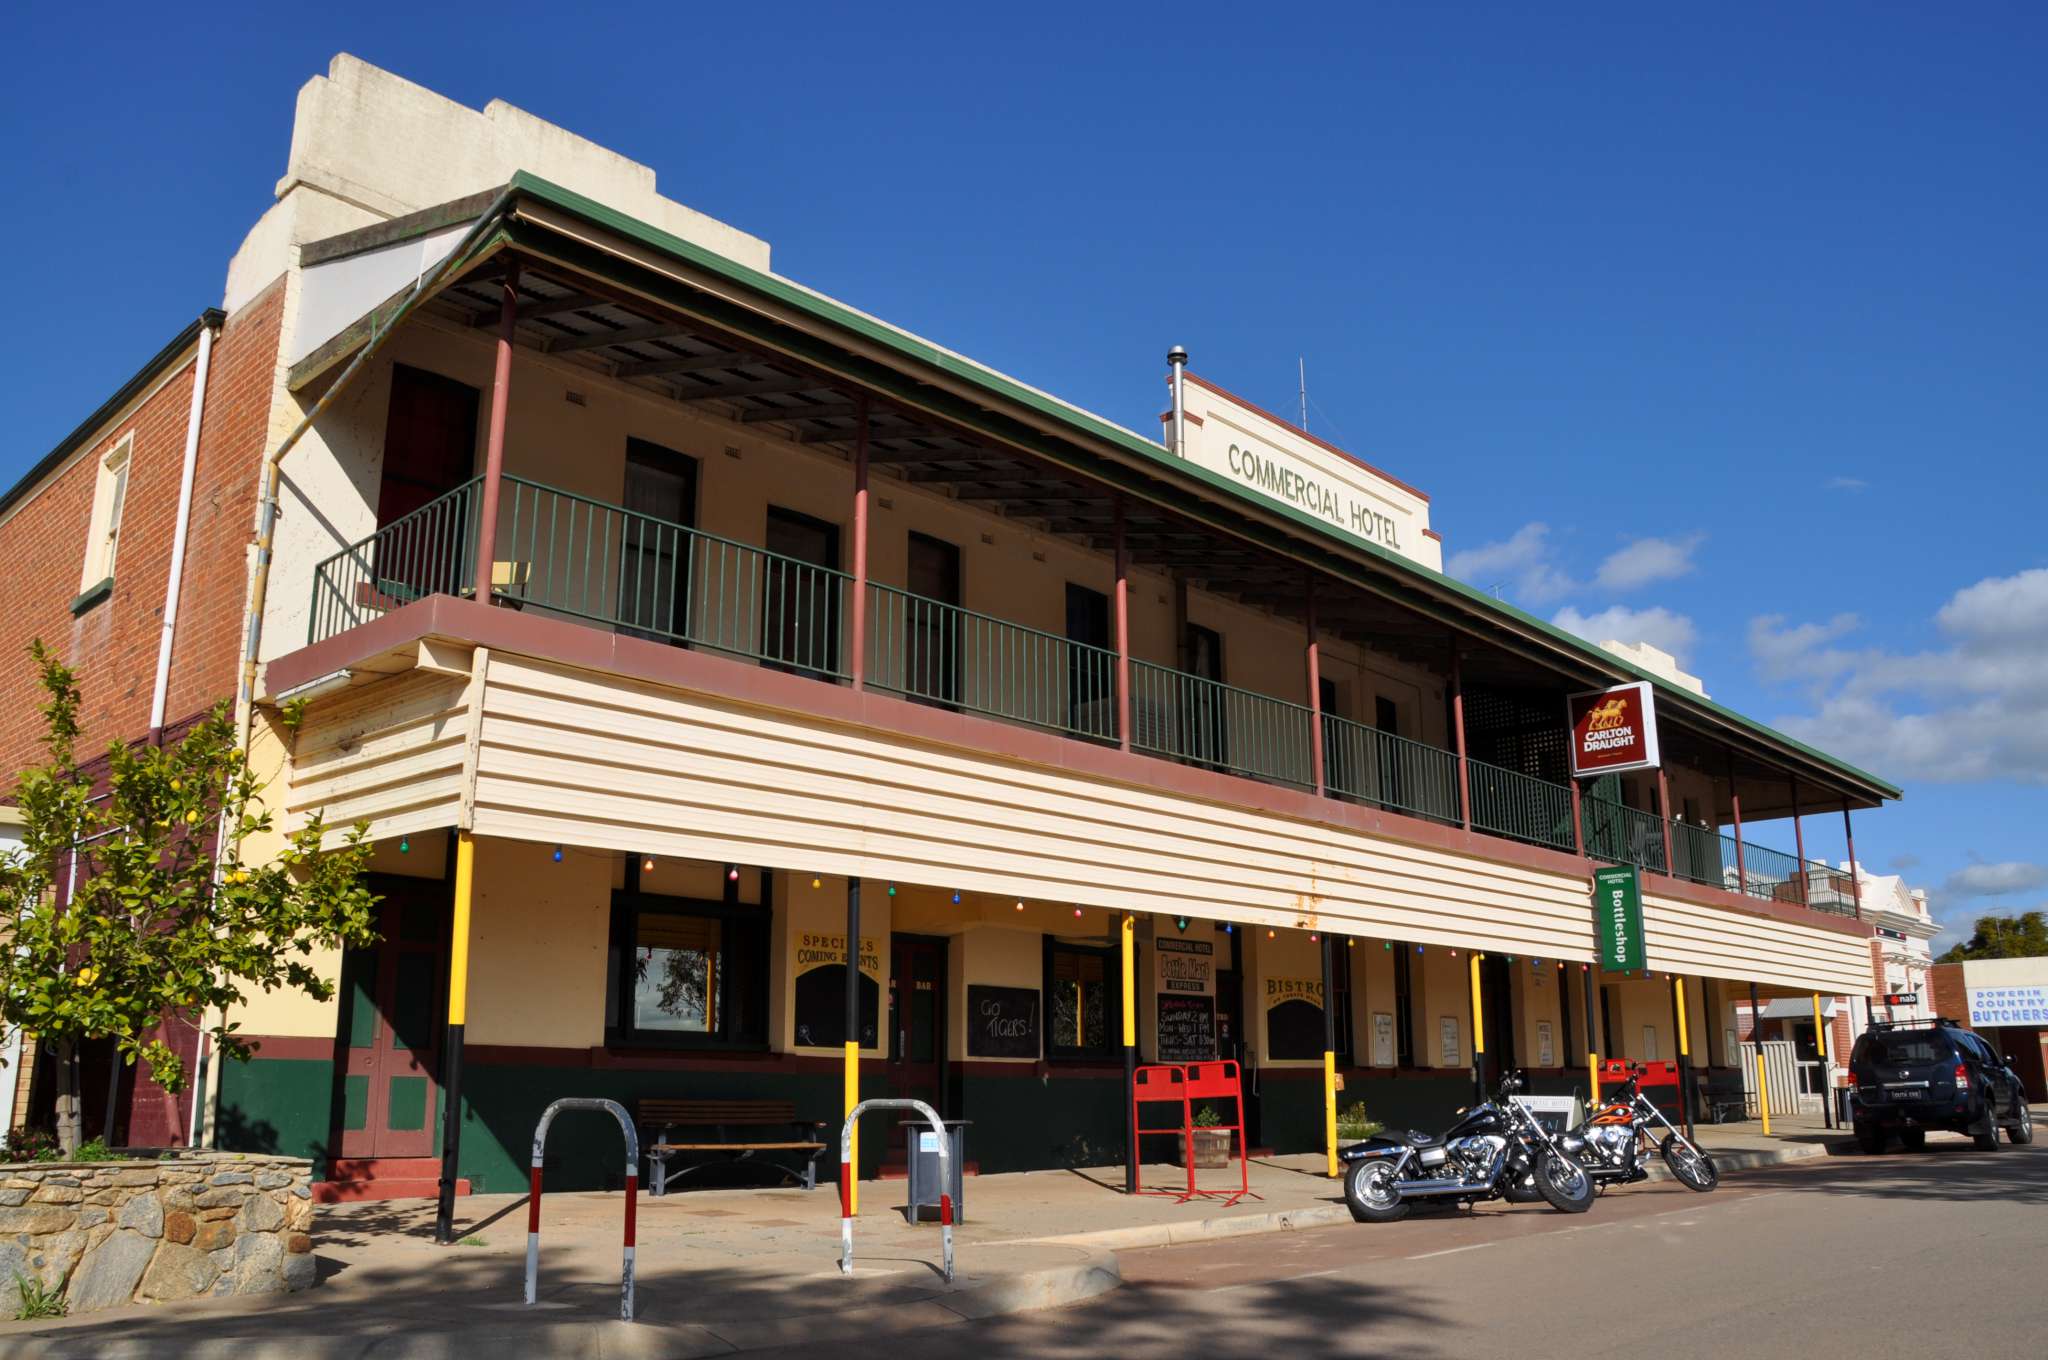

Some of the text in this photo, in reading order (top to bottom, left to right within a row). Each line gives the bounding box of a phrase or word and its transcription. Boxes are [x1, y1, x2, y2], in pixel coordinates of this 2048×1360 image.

[1228, 444, 1400, 549] COMMERCIAL HOTEL
[1585, 726, 1632, 742] CARLTON
[1583, 735, 1635, 752] DRAUGHT
[1612, 890, 1628, 963] Bottleshop
[803, 935, 874, 952] SPECIS
[798, 949, 837, 964] COMING
[916, 981, 931, 990] BAR
[1901, 994, 1915, 1003] nab
[1976, 989, 2040, 998] DOWERIN
[1975, 999, 2044, 1008] COUNTRY
[1973, 1008, 2048, 1022] BUTCHERS
